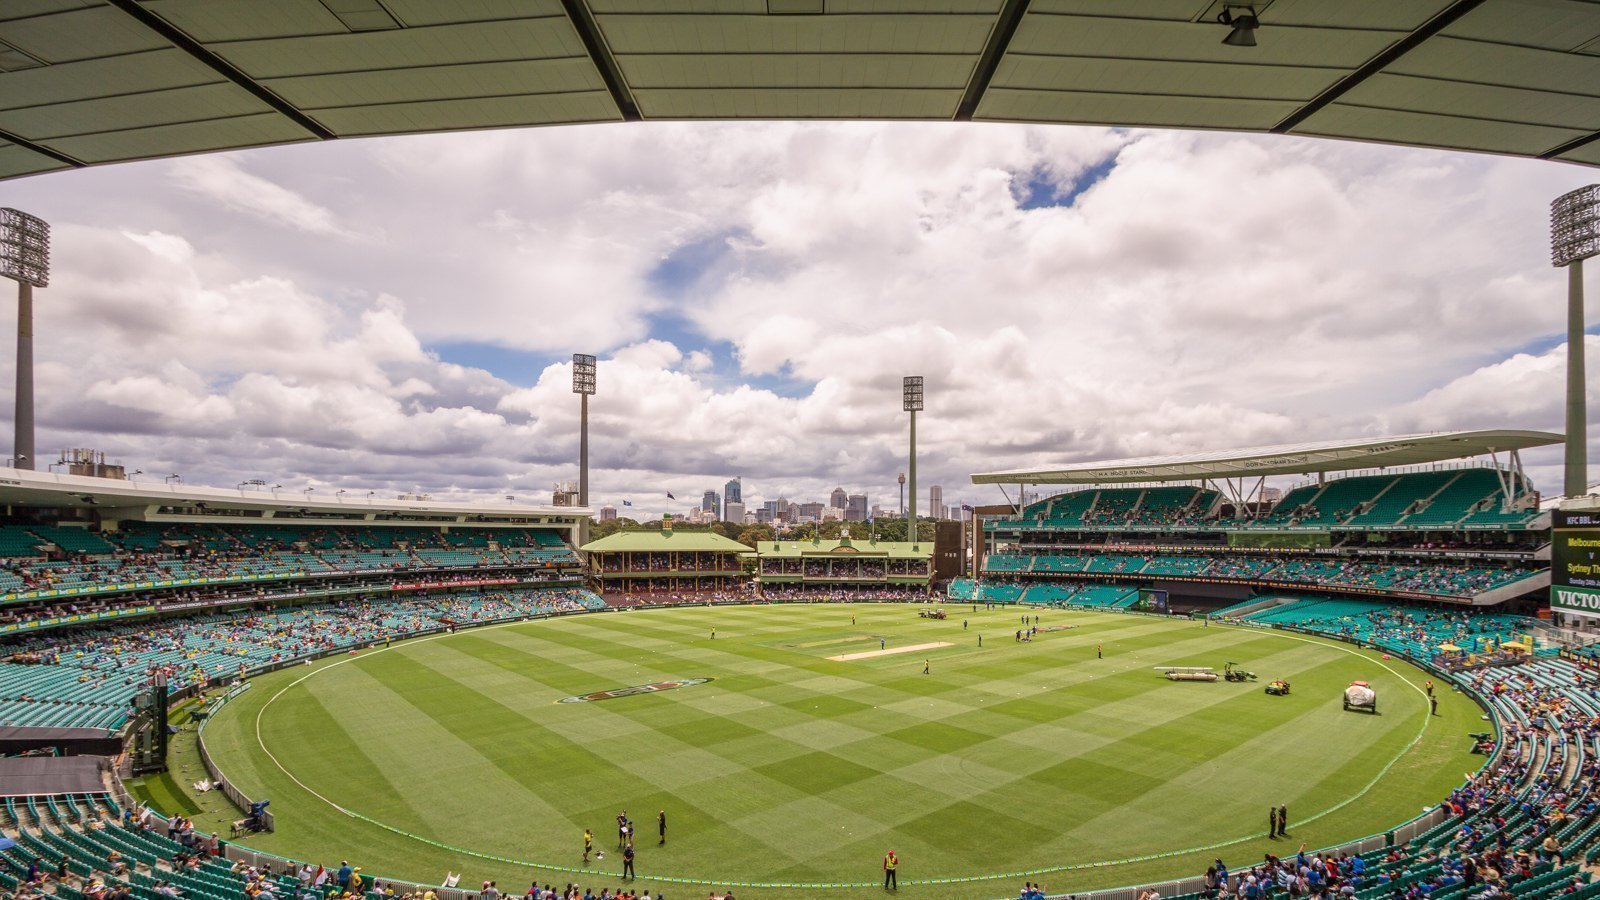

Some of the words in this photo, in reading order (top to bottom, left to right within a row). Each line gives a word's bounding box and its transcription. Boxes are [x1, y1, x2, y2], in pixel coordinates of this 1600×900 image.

[1567, 516, 1578, 525] KFC
[1580, 516, 1591, 525] BBL
[1568, 538, 1600, 547] Melbourne
[1568, 563, 1591, 575] Sydney
[1558, 590, 1600, 609] VICTO
